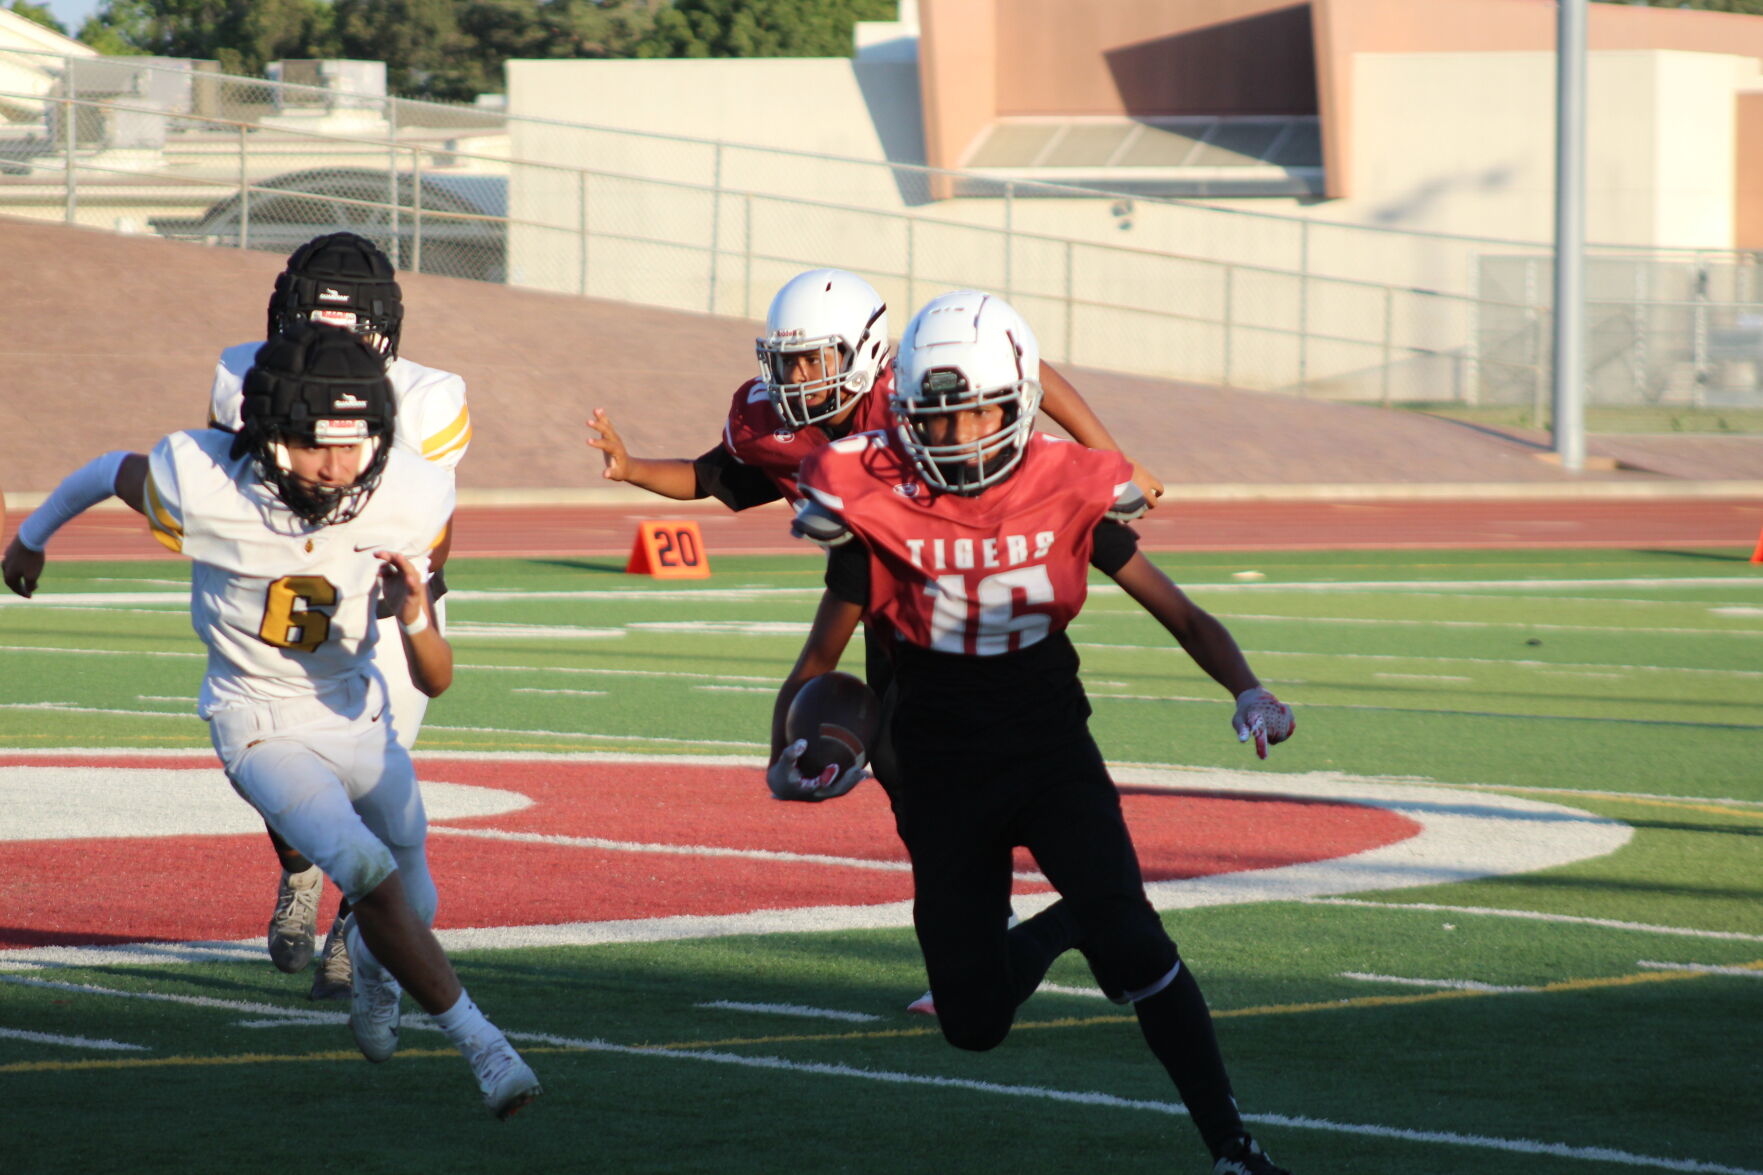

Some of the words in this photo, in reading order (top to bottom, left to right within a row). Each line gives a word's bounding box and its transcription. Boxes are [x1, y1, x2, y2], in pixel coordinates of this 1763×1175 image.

[654, 530, 698, 567] 20
[906, 530, 1055, 570] TIGERS
[259, 575, 337, 653] 6
[923, 563, 1055, 656] 16
